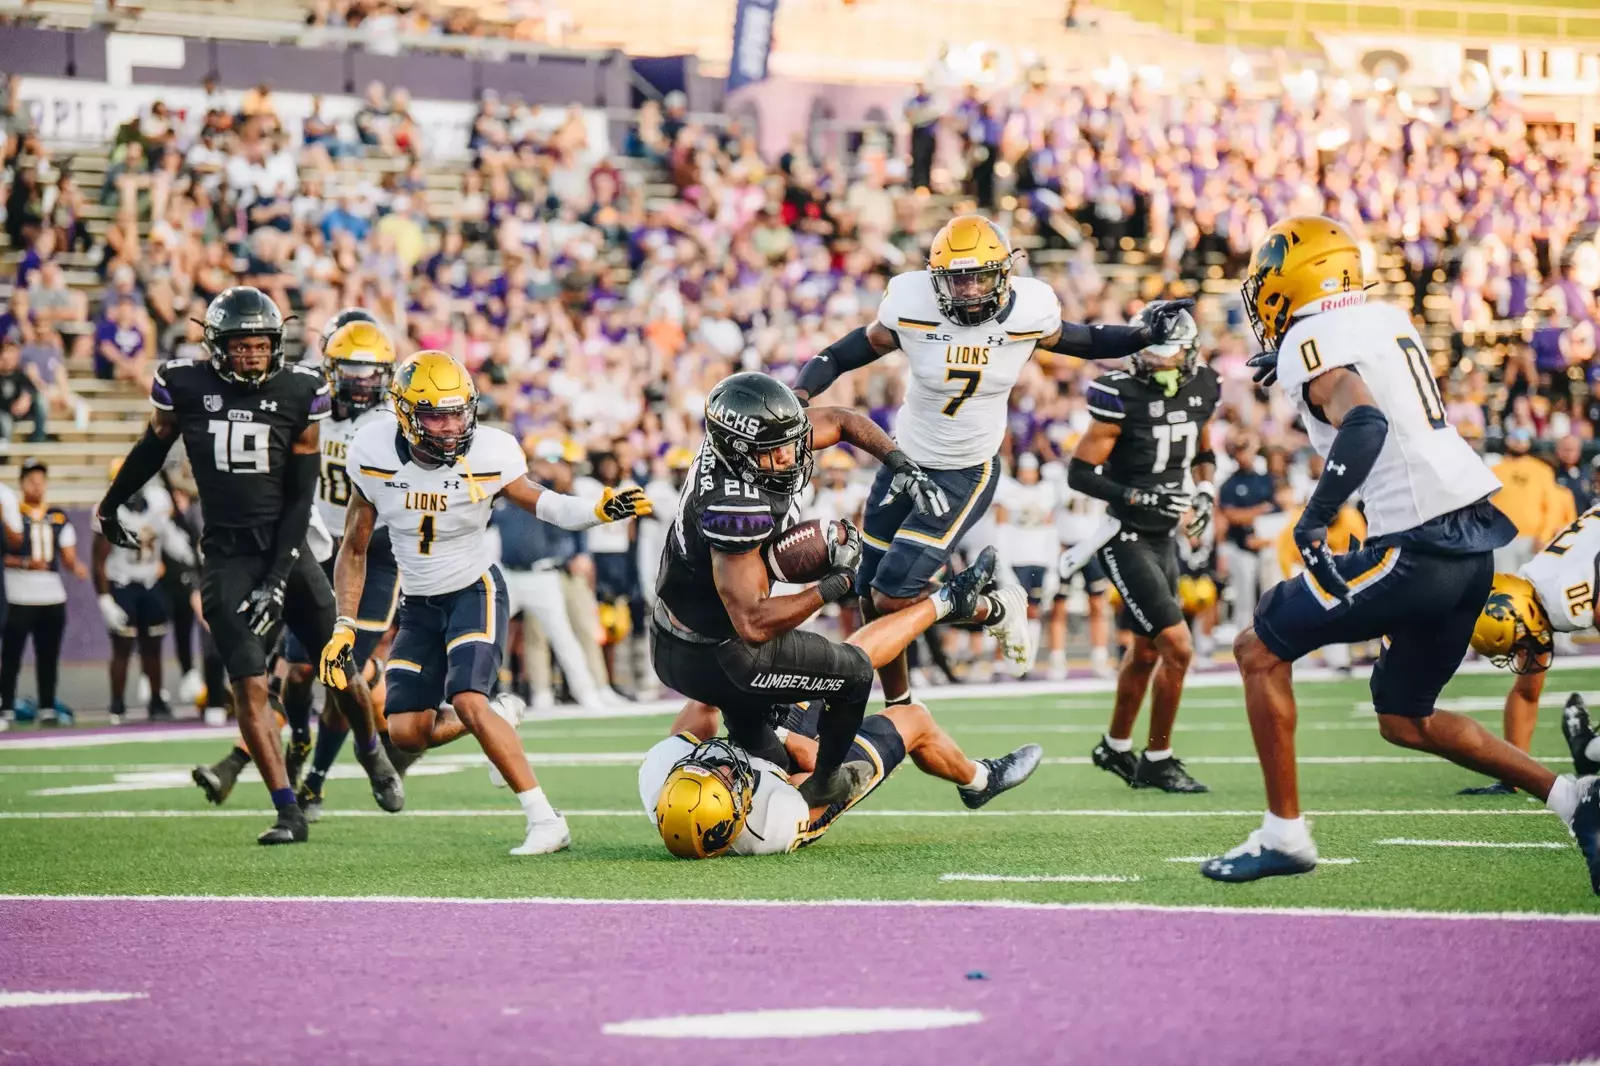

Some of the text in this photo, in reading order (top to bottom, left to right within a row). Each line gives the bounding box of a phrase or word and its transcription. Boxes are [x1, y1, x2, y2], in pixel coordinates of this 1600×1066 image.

[945, 344, 991, 365] LIONS
[1299, 337, 1323, 374] 0
[941, 367, 984, 419] 7
[708, 401, 761, 437] JACKS
[207, 419, 272, 475] 19
[404, 491, 449, 512] LIONS
[417, 514, 436, 556] 1
[1565, 582, 1594, 618] 30
[750, 672, 845, 691] LUMBERJACKS
